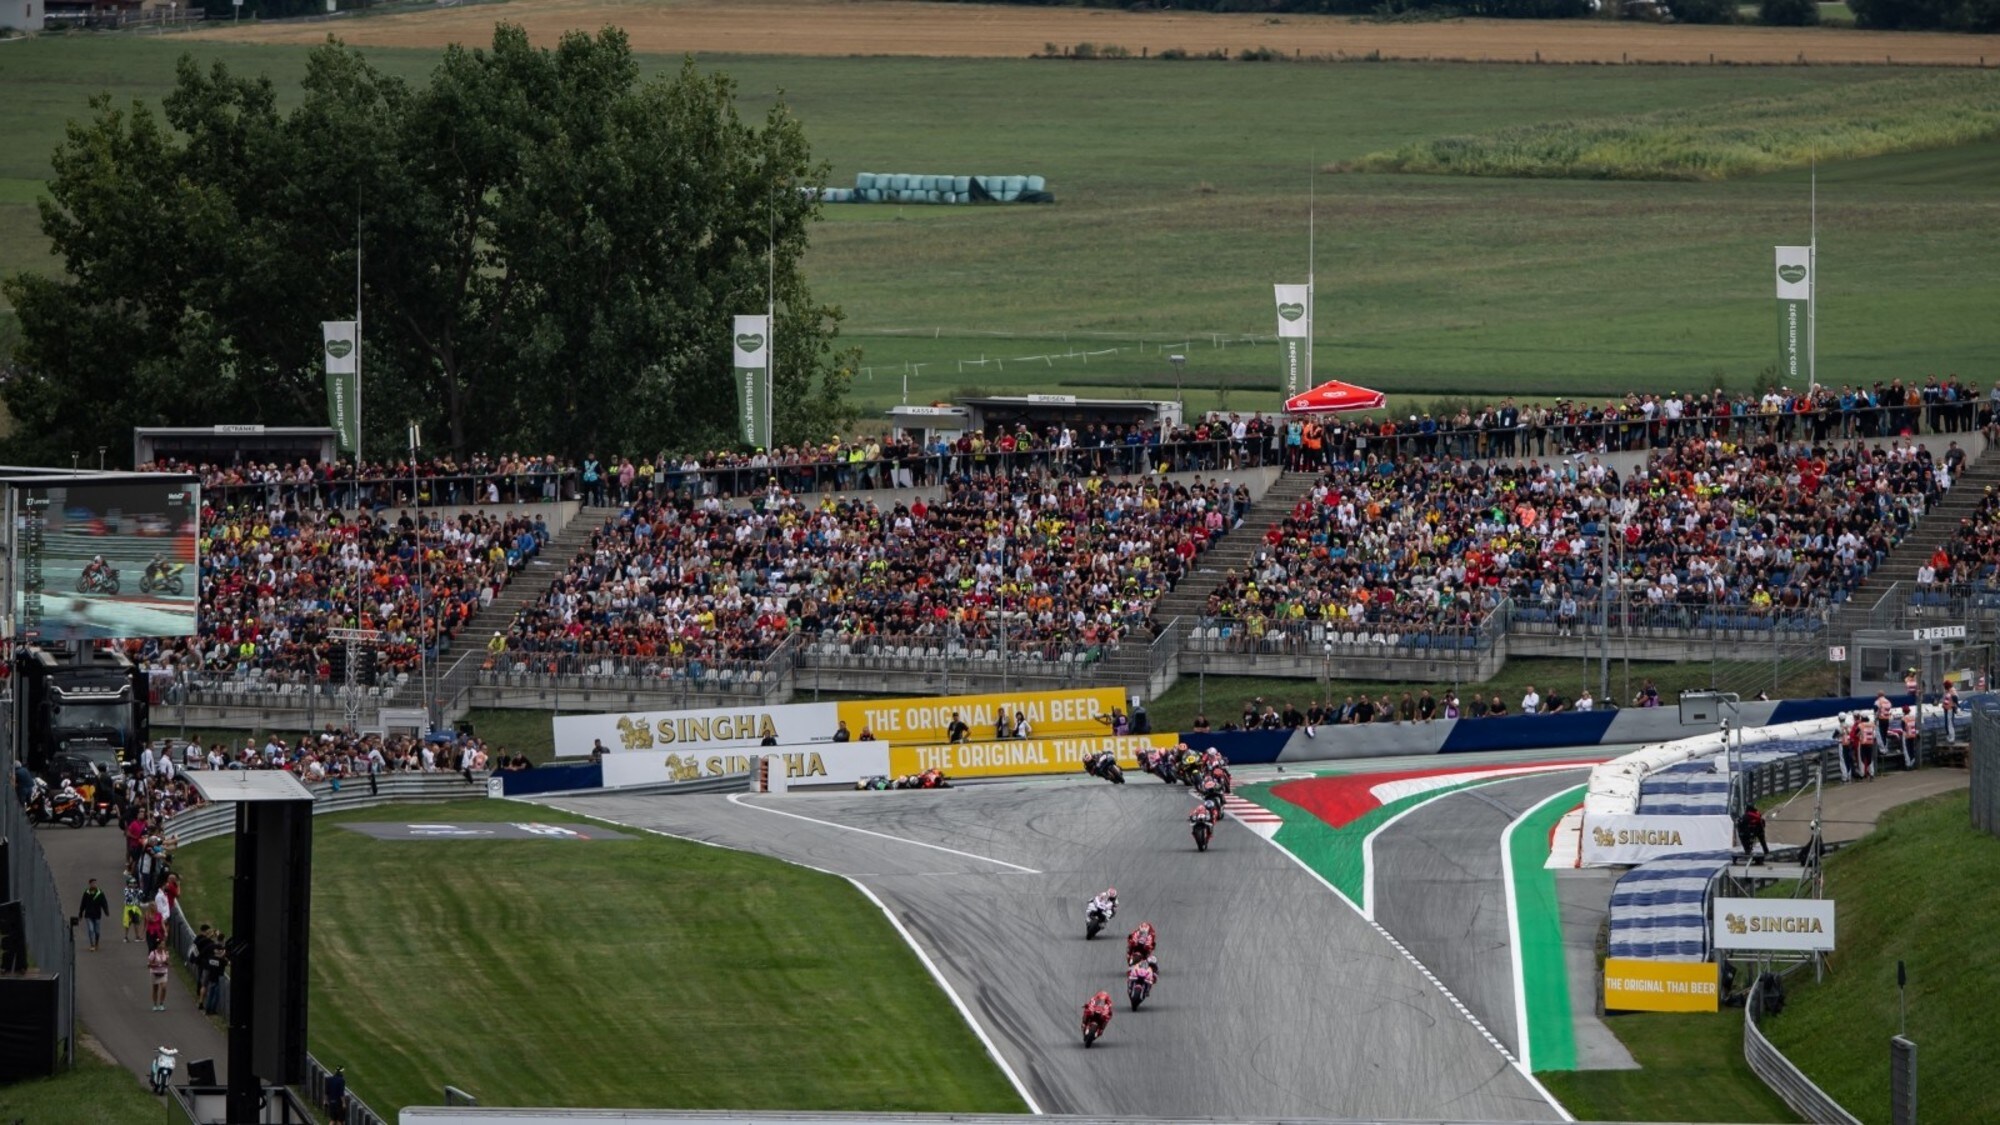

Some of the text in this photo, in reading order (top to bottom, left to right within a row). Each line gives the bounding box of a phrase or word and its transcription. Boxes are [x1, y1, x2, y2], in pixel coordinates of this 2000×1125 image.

[912, 407, 935, 415] KASSA
[865, 708, 900, 732] THE
[1051, 698, 1101, 722] BEER
[657, 714, 779, 743] SINGHA
[915, 747, 952, 769] THE
[958, 742, 1049, 767] ORIGINAL
[1053, 738, 1098, 763] THAI
[705, 753, 828, 778] SINHA
[1618, 829, 1683, 846] SINGHA
[1749, 916, 1823, 933] SINGHA
[1606, 978, 1716, 994] THE ORIGINAL THAI BEER
